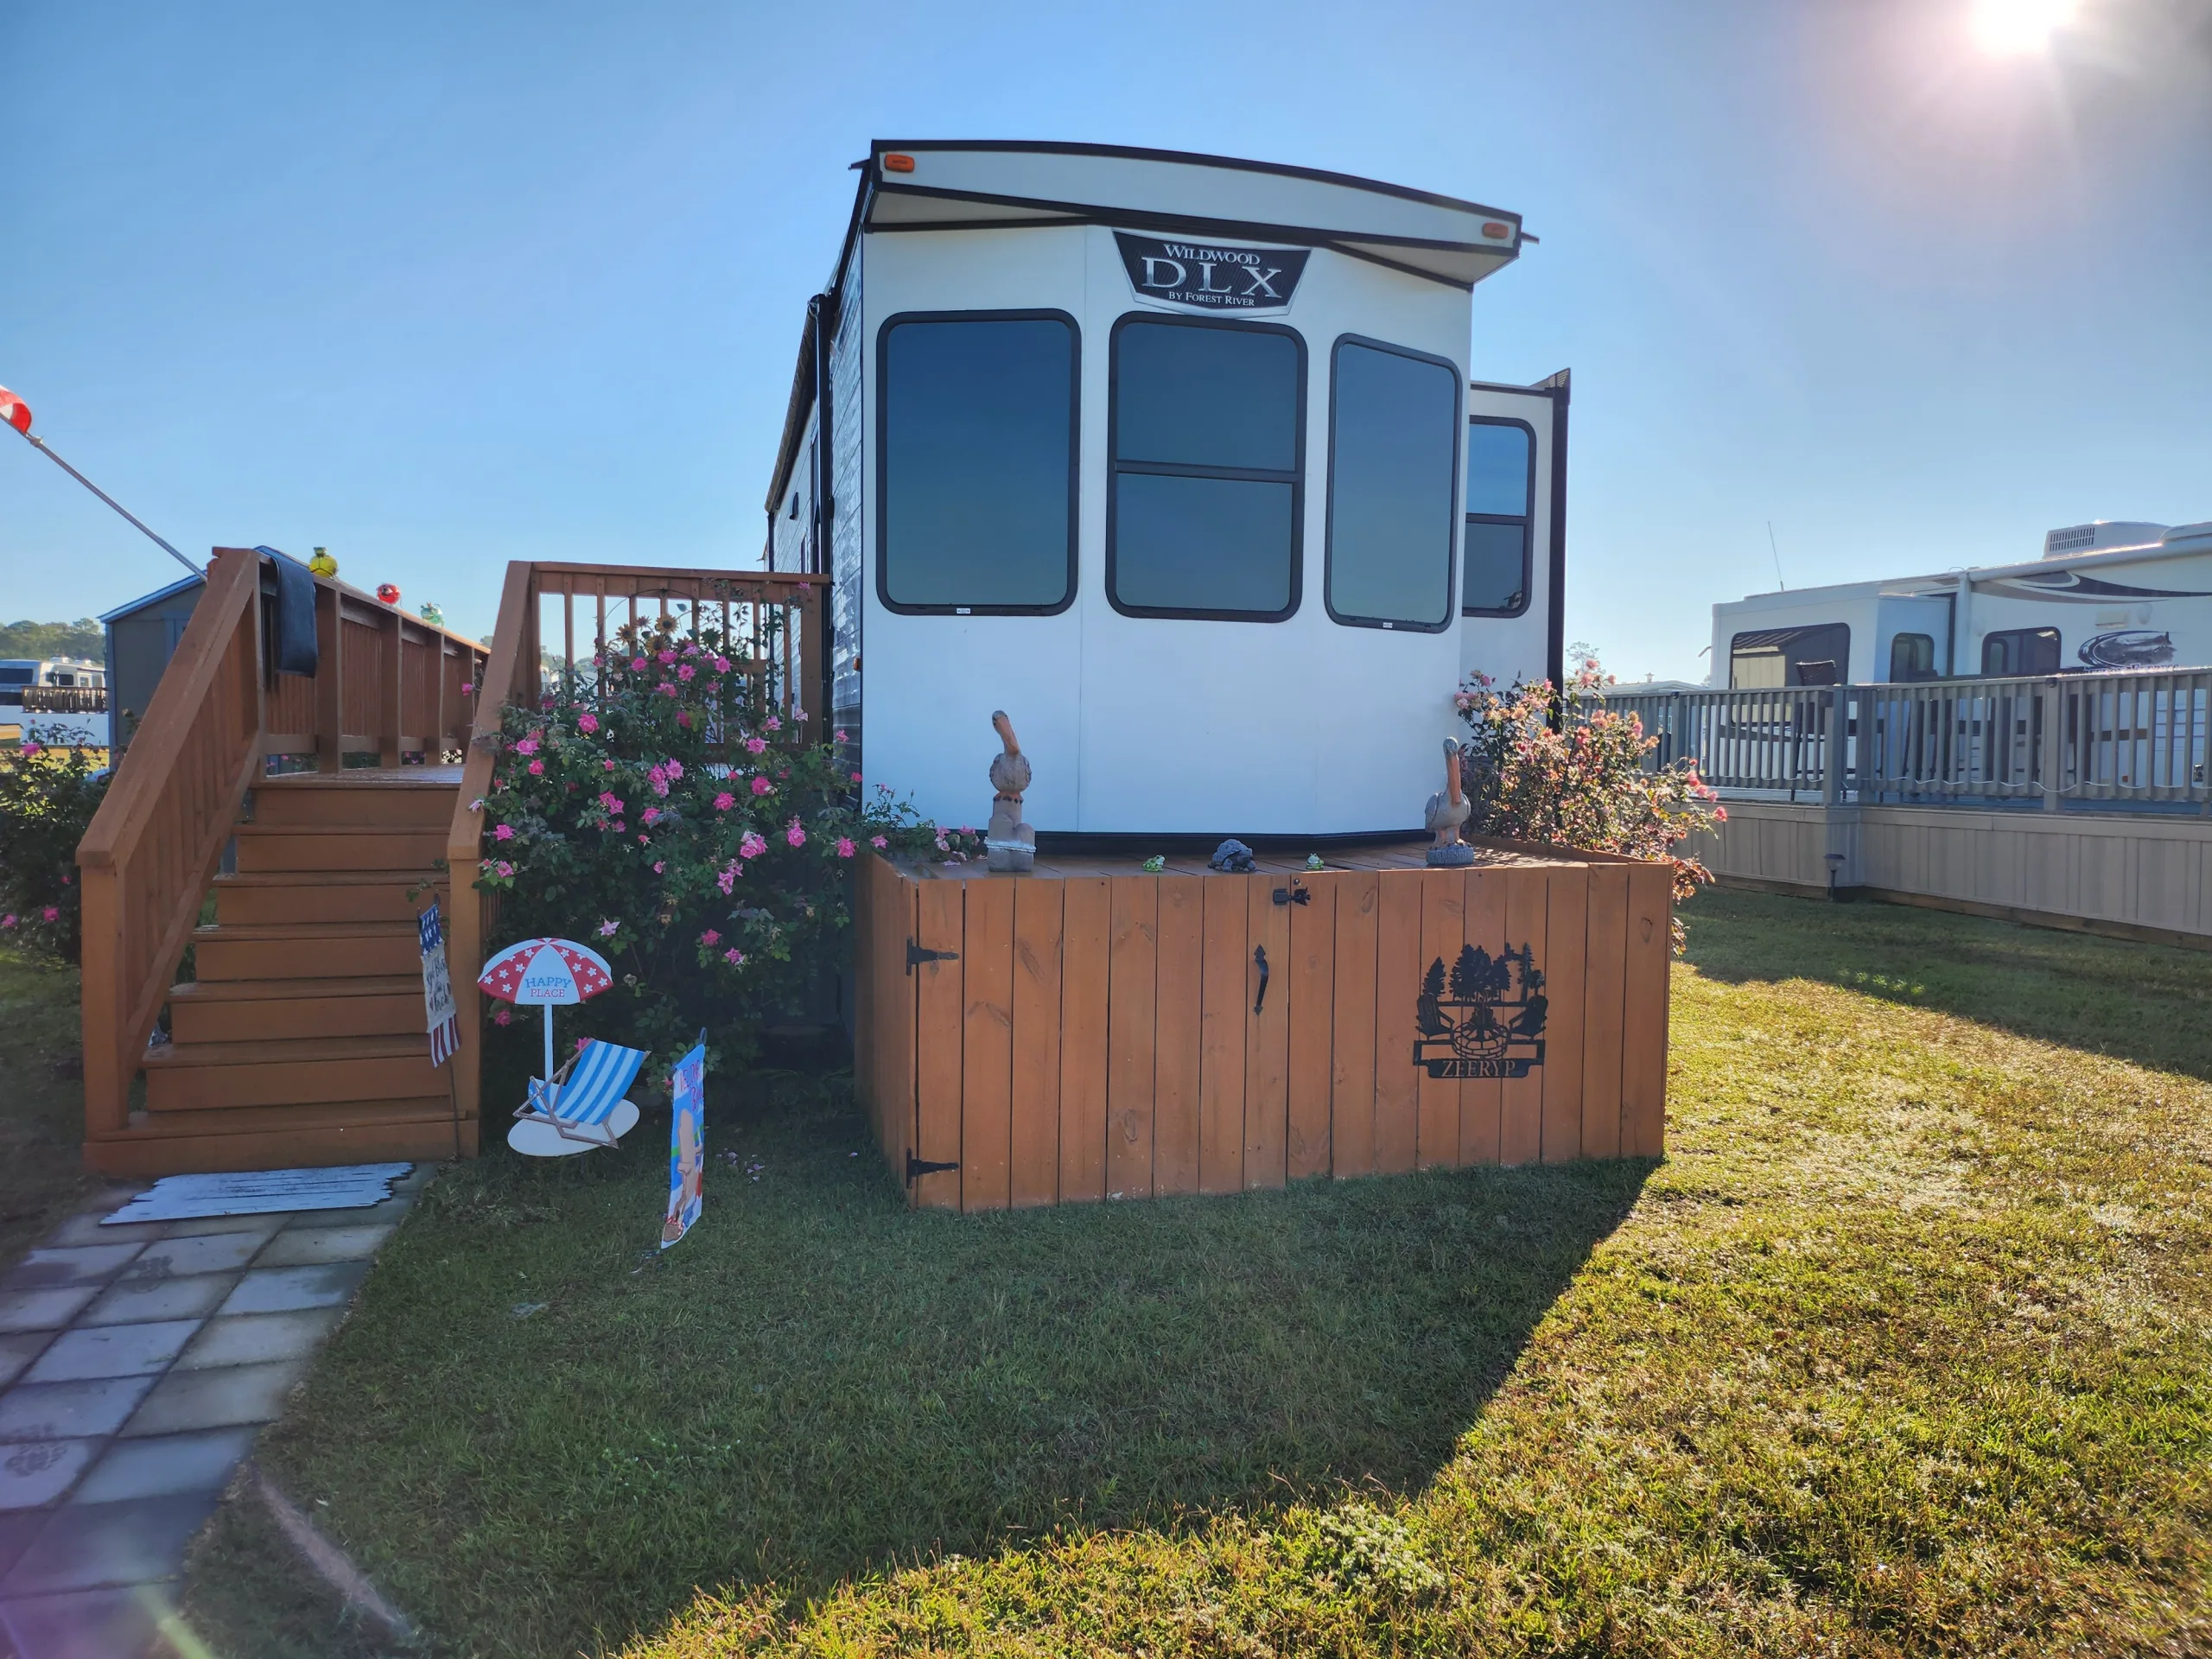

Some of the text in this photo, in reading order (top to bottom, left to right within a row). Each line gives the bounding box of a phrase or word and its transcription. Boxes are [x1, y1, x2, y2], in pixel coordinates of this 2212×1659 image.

[1163, 243, 1261, 265] WILDWOOD
[1141, 257, 1282, 298] DLX
[1168, 291, 1255, 307] BY FOREST RIVER
[524, 976, 572, 988] HAPPY
[530, 988, 565, 998] PLACE
[1441, 1060, 1516, 1077] ZEERYP
